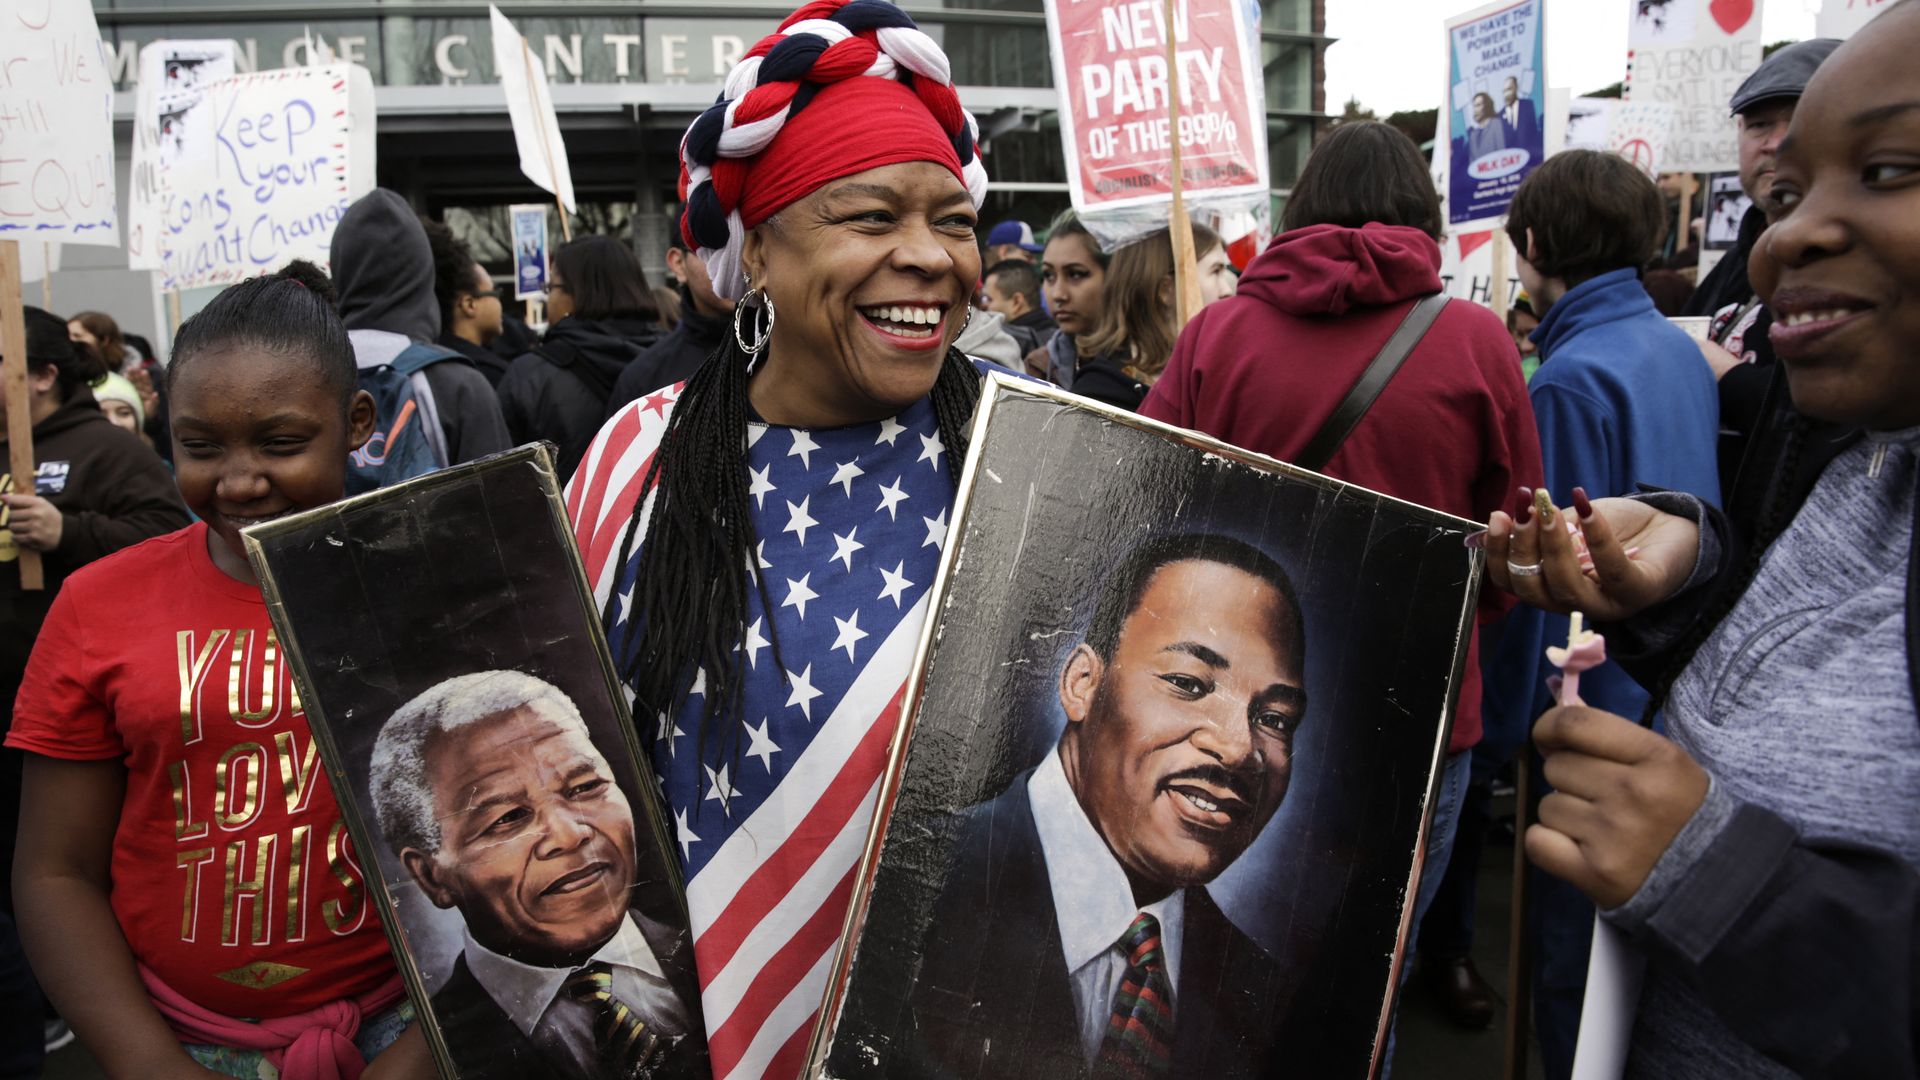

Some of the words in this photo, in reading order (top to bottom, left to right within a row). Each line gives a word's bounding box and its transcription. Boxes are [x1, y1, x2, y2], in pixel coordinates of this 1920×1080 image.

[1102, 0, 1189, 53] NEW
[1460, 25, 1476, 40] WE
[1479, 14, 1510, 33] HAVE
[1513, 3, 1533, 21] THE
[1466, 29, 1508, 53] POWER
[1511, 22, 1526, 37] TO
[435, 33, 745, 79] CNTER
[1474, 53, 1521, 78] CHANGE
[1482, 41, 1513, 61] MAKE
[1081, 46, 1224, 120] PARTY
[1088, 125, 1119, 160] OF
[1122, 118, 1172, 154] THE
[1177, 110, 1237, 148] 99%
[253, 156, 330, 205] your
[1477, 159, 1498, 173] MLK
[1502, 153, 1521, 168] DAY
[169, 730, 322, 842] LOV
[176, 818, 367, 947] THIS
